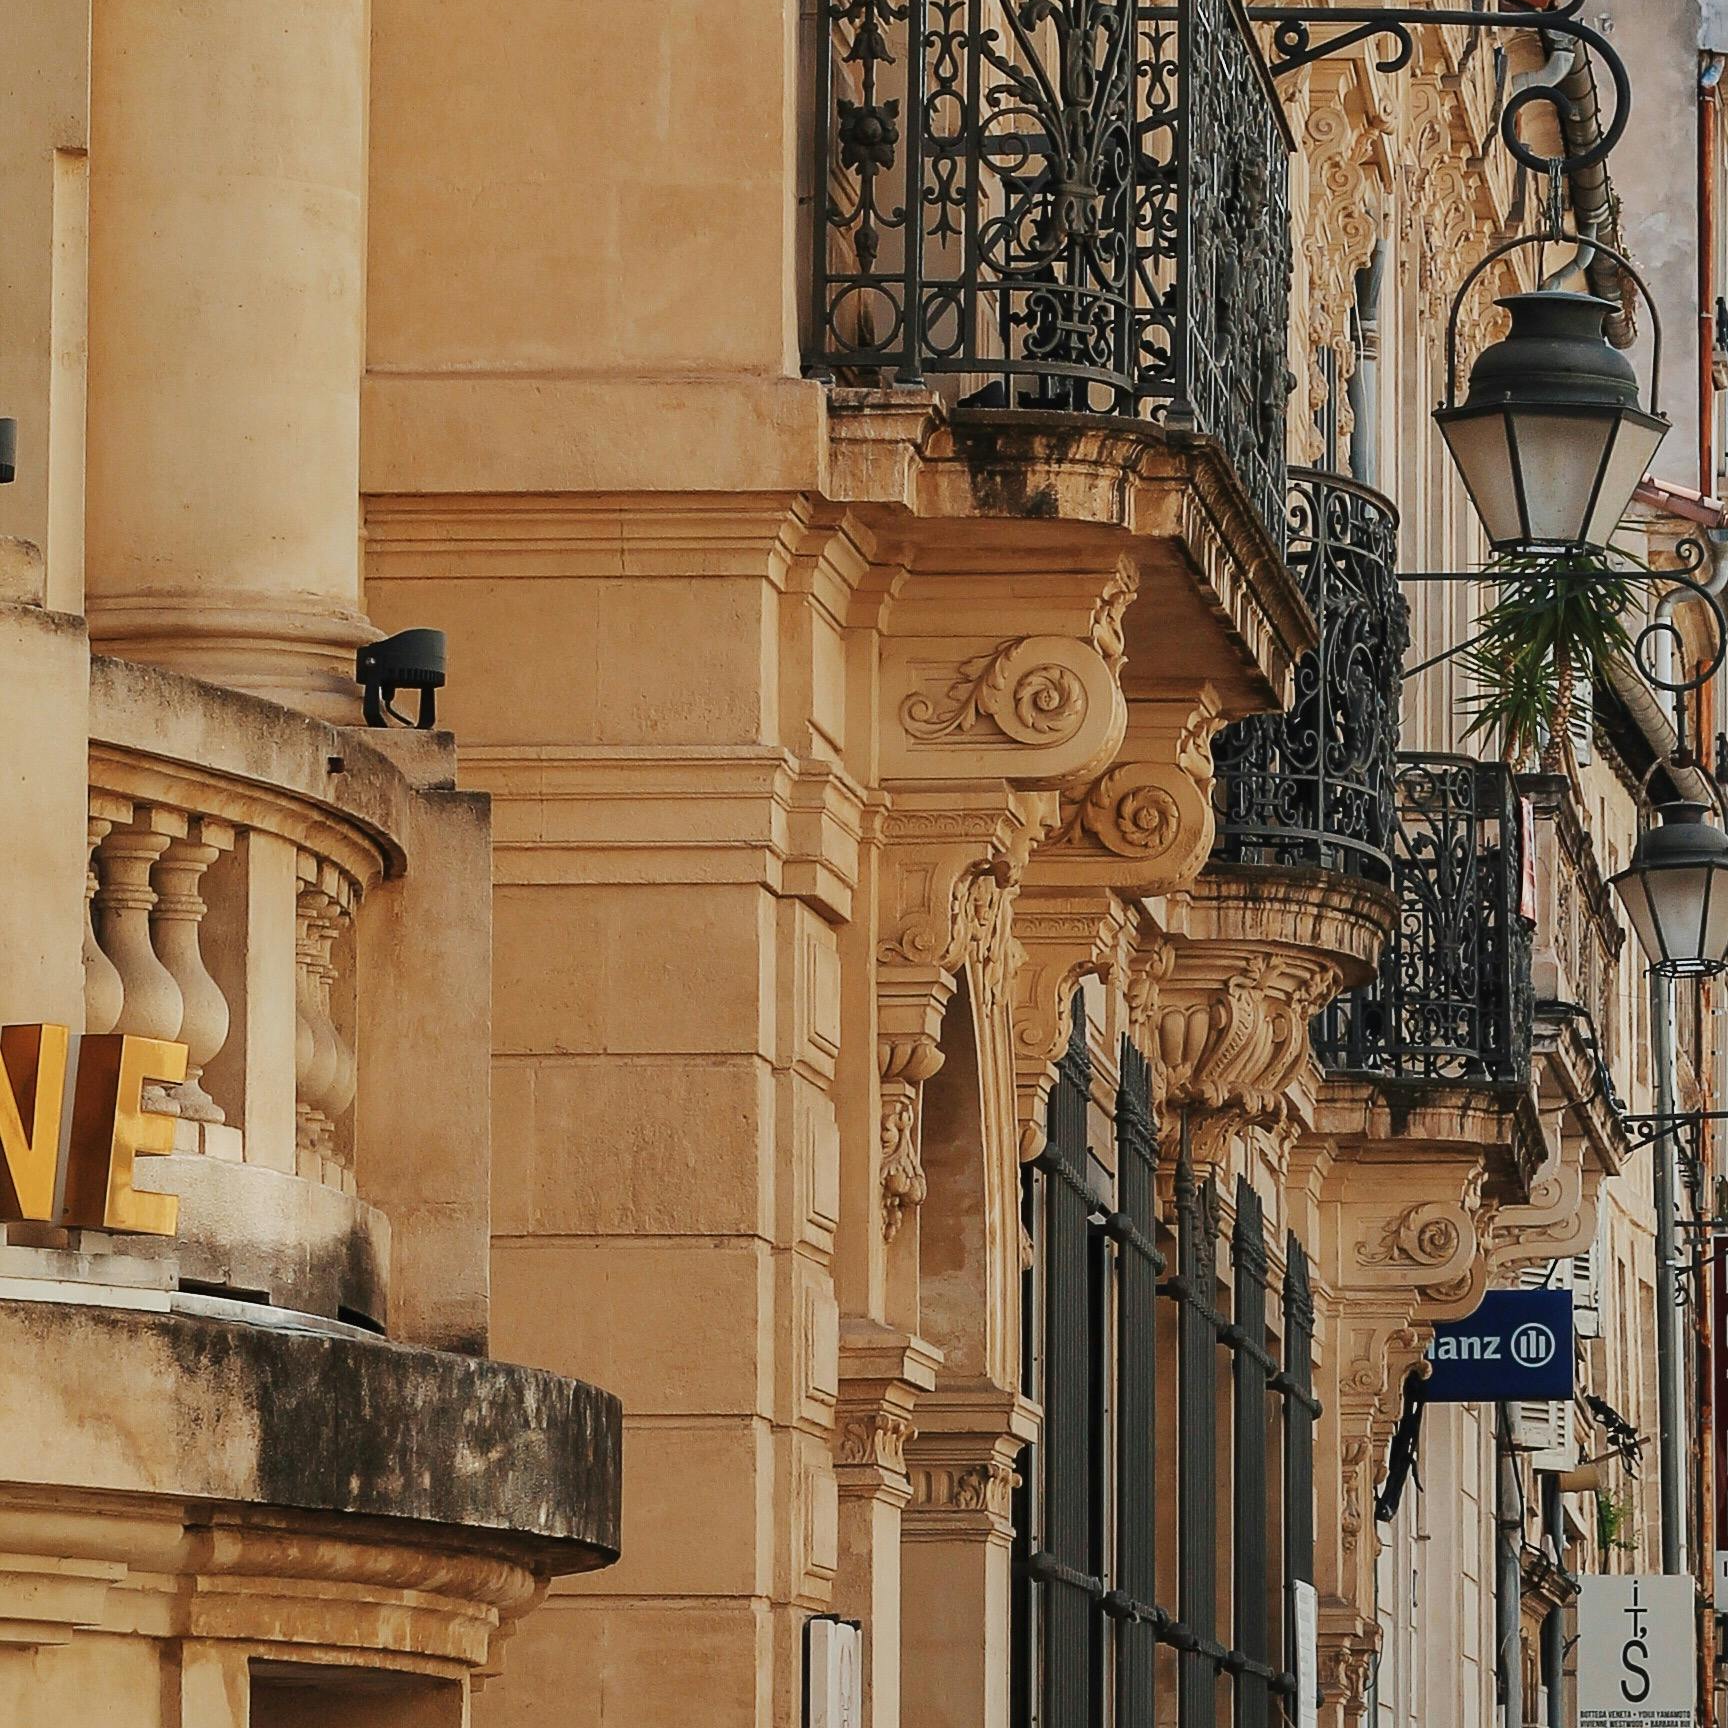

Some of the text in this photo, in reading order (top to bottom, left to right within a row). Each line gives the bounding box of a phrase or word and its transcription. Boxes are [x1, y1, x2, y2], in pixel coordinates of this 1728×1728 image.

[1580, 1710, 1607, 1719] BOTTEGA
[1608, 1710, 1632, 1719] VENETA
[1580, 1720, 1608, 1728] VIVIENNE
[1609, 1720, 1643, 1728] WESTWOOD
[1650, 1720, 1679, 1728] BARBARA
